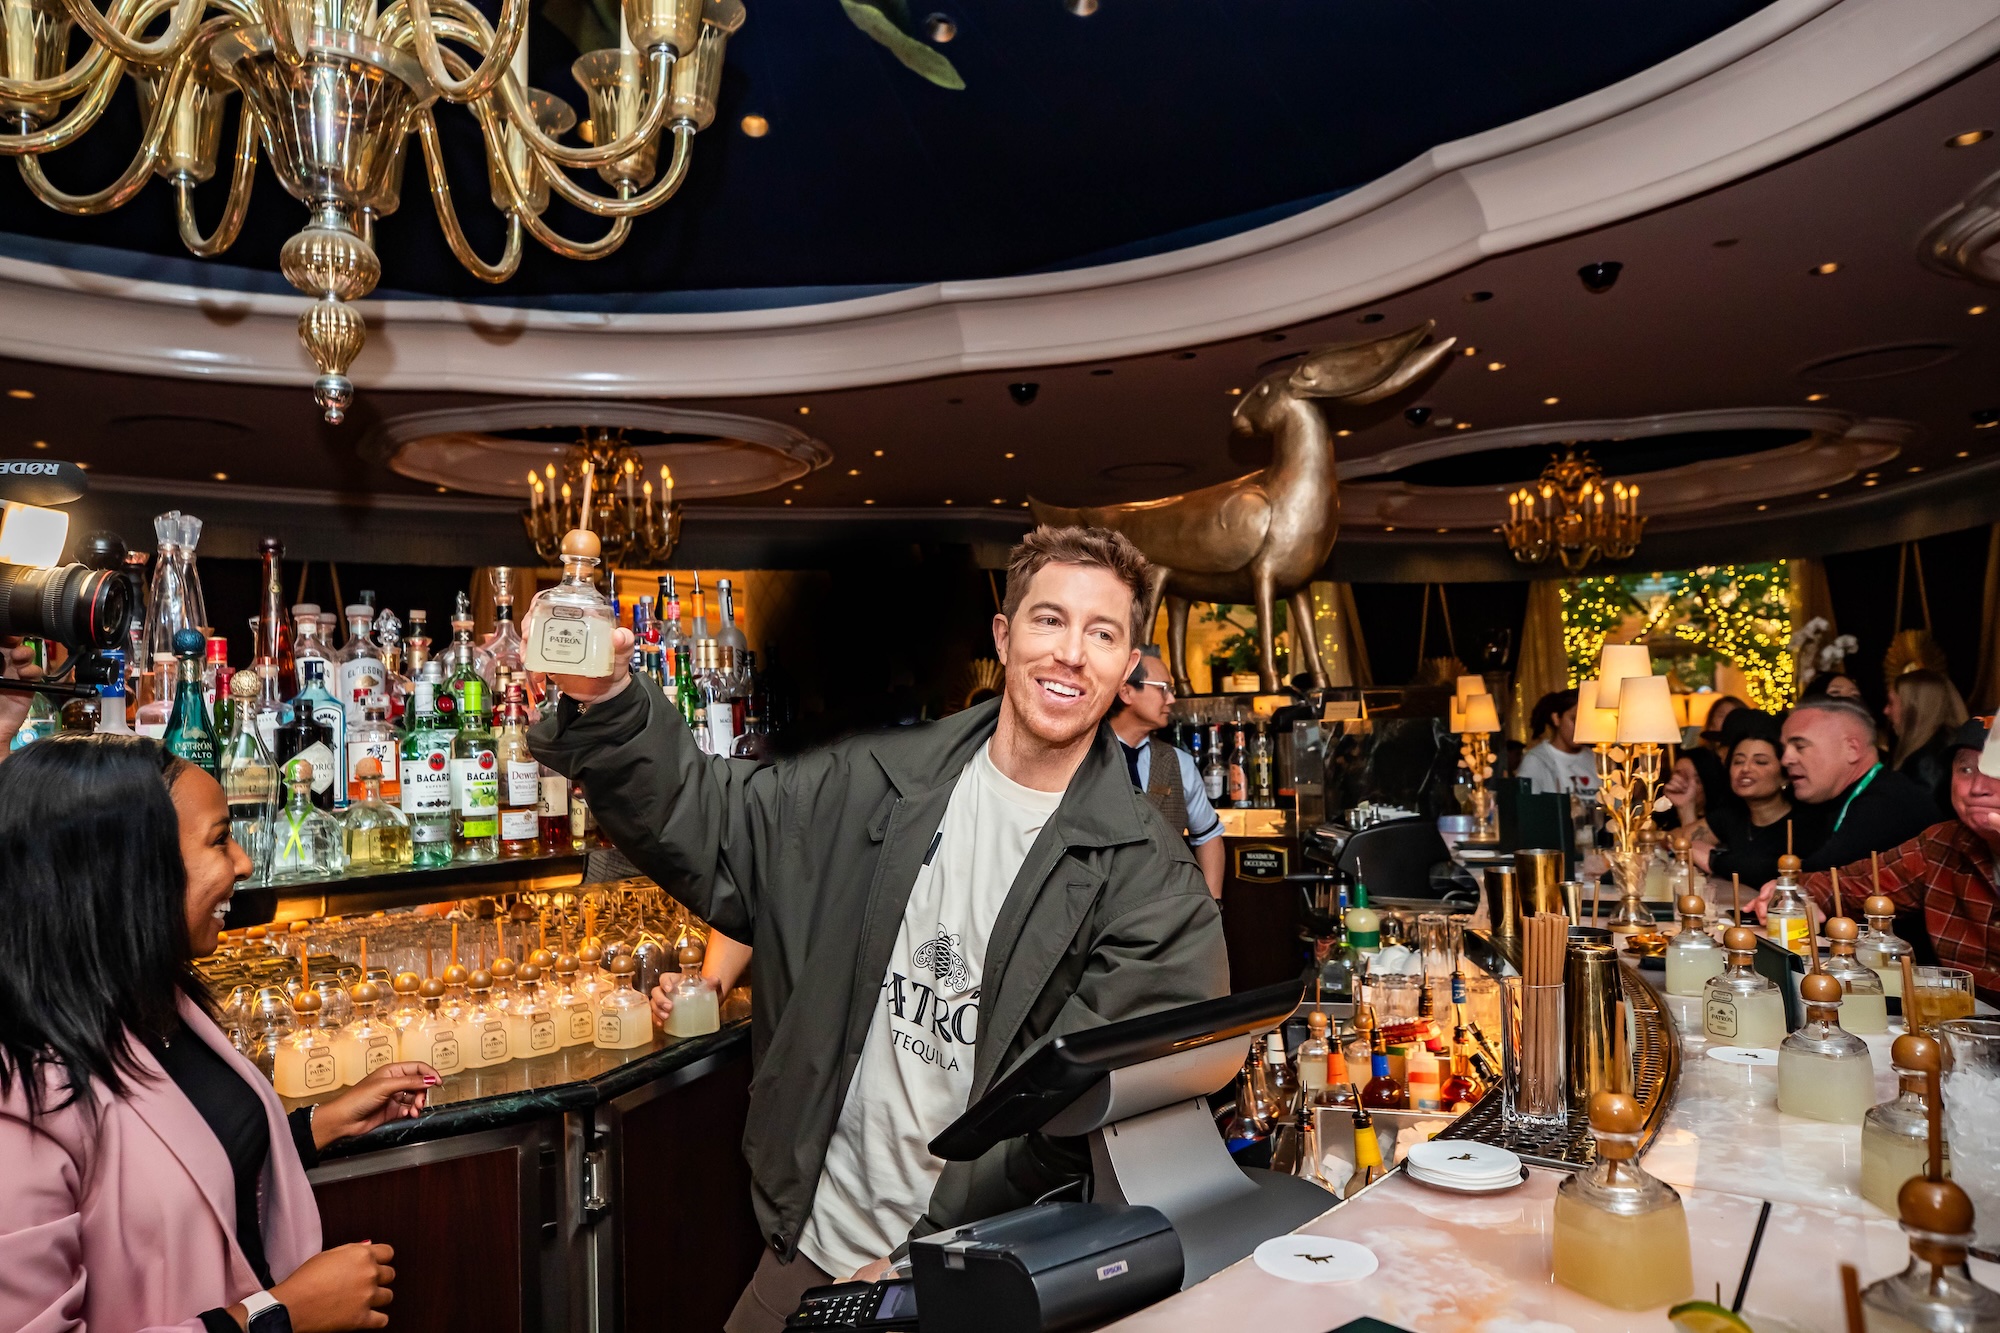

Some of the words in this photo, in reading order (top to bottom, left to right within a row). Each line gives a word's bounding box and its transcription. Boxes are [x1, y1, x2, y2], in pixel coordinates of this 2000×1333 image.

[0, 462, 60, 476] RØDE
[549, 635, 582, 645] PATRÓN
[191, 751, 213, 759] ALTO
[1246, 852, 1276, 860] MAXIMUM
[1243, 860, 1279, 868] OCCUPANCY
[881, 972, 980, 1045] ATRÓ
[892, 1029, 959, 1072] TEQUILA
